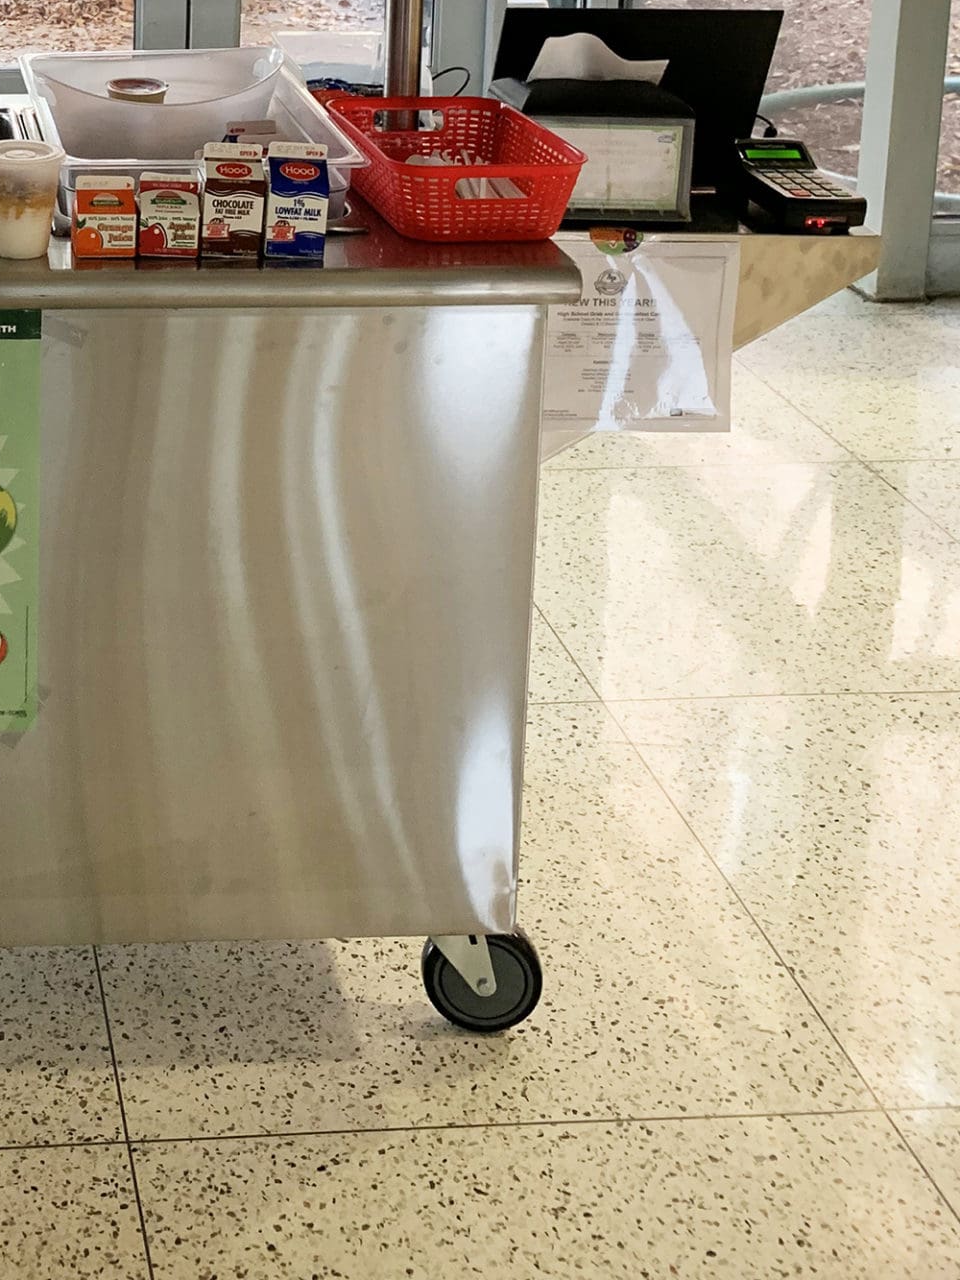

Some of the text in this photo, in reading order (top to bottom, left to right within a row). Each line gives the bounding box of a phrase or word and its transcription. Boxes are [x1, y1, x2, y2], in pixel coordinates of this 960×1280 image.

[220, 166, 248, 175] Hood
[285, 166, 315, 176] Hood
[212, 199, 254, 209] CHOCOLATE
[293, 199, 305, 207] 1%
[275, 207, 321, 217] LOWFAT MILK
[98, 223, 133, 233] Orange
[593, 298, 616, 307] THIS
